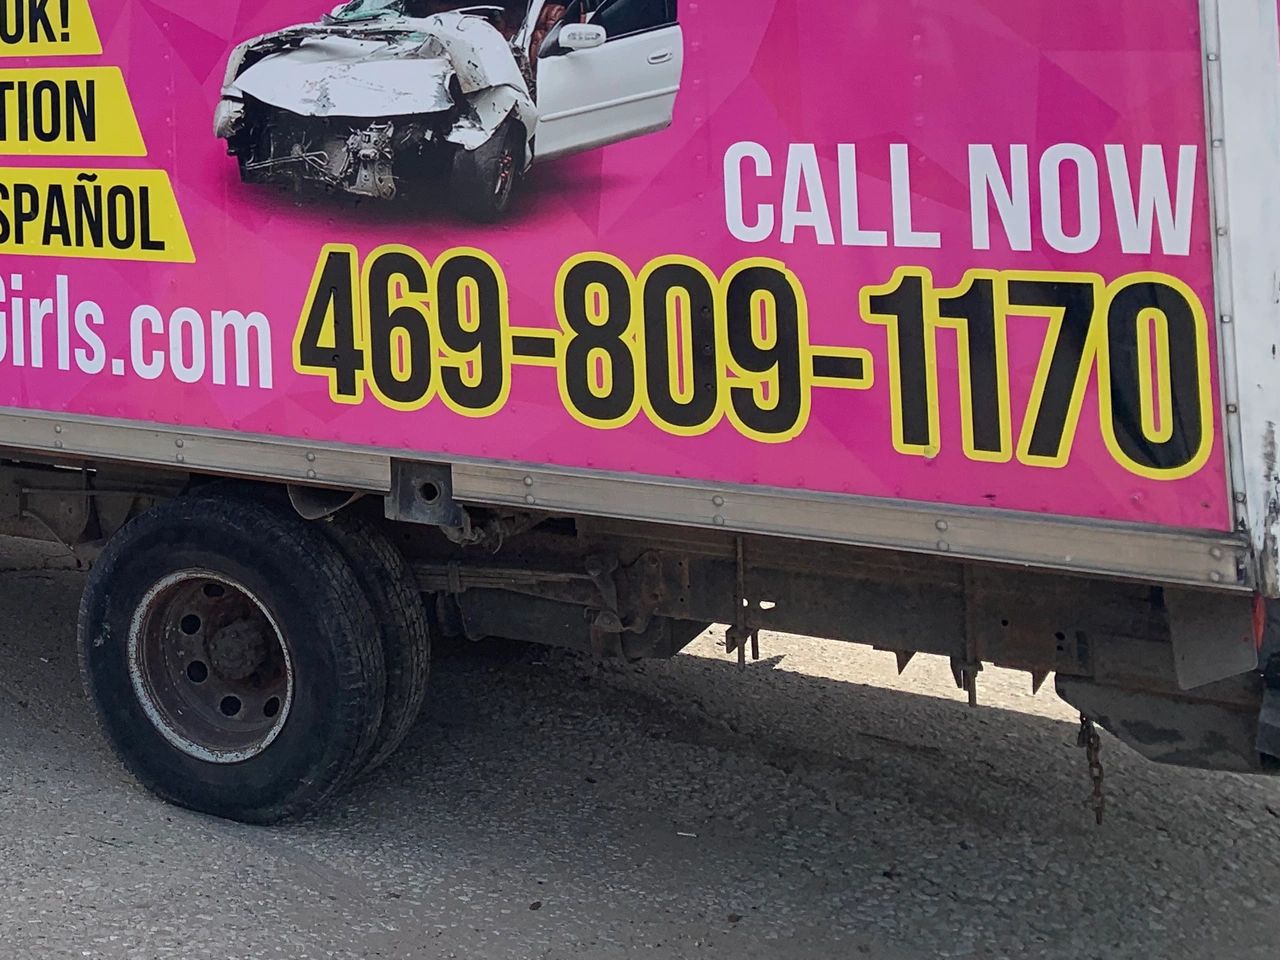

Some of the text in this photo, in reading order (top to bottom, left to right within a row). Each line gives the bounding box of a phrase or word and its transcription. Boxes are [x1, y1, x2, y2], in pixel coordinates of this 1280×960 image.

[723, 141, 1197, 256] CALL NOW
[293, 243, 1213, 482] 469-809-1170
